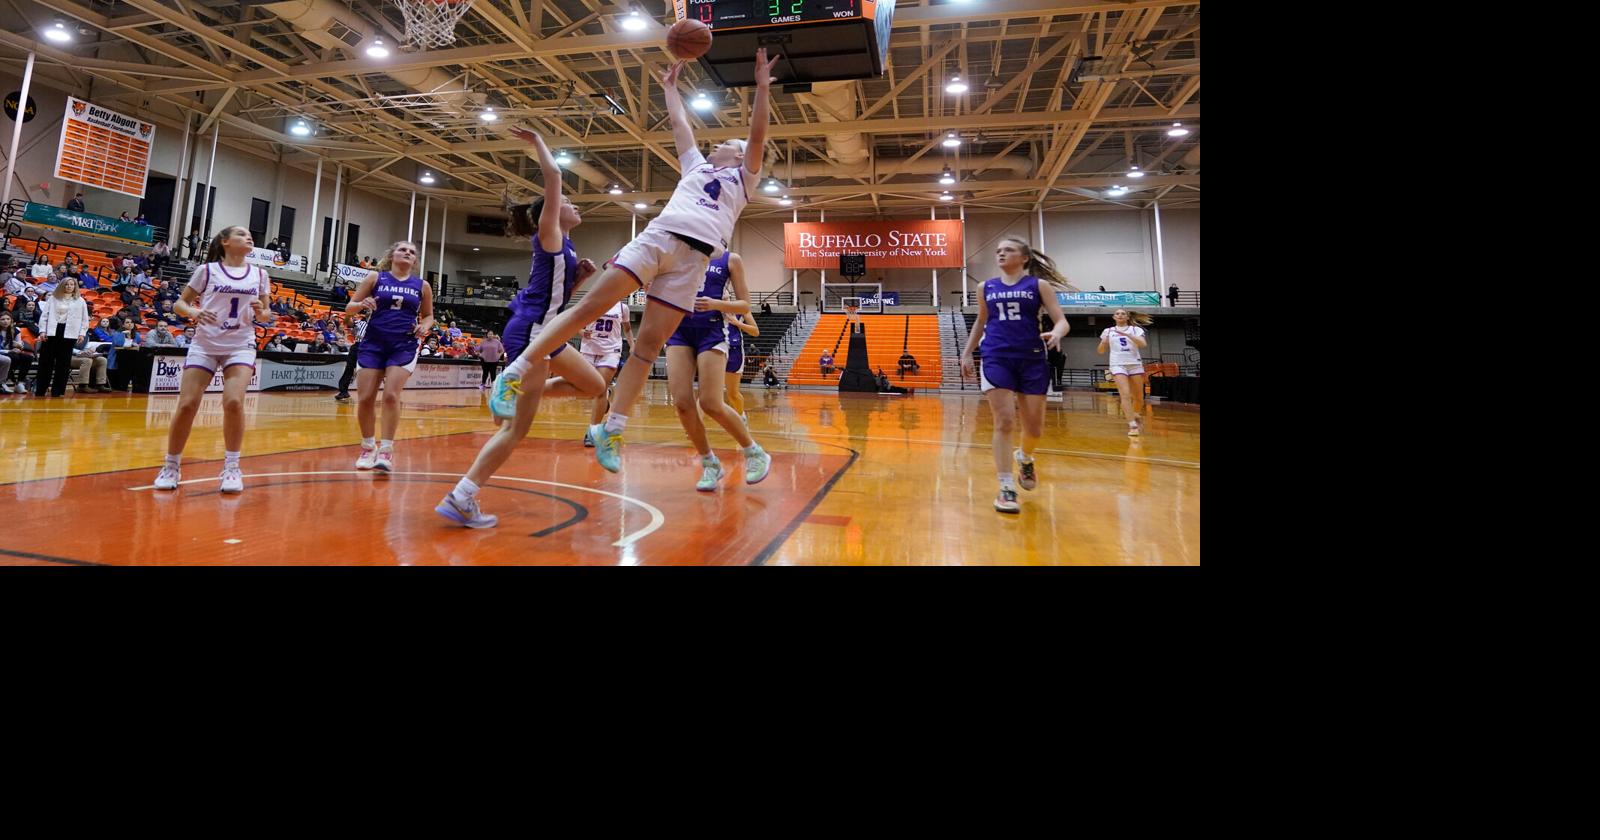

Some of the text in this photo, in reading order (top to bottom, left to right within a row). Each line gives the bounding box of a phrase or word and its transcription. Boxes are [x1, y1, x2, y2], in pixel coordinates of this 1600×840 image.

[771, 15, 801, 24] GAMES
[833, 10, 854, 18] WON
[5, 99, 35, 115] NCA
[89, 106, 137, 129] Betty Abgott
[799, 230, 947, 248] BUFFALO STATE
[800, 248, 947, 258] The State University of New York
[378, 285, 419, 297] HAMBURG
[229, 297, 239, 318] 1
[390, 295, 404, 310] 3
[996, 302, 1021, 320] 12
[595, 319, 613, 332] 20
[1119, 337, 1127, 346] 5
[271, 370, 335, 380] HART HOTELS
